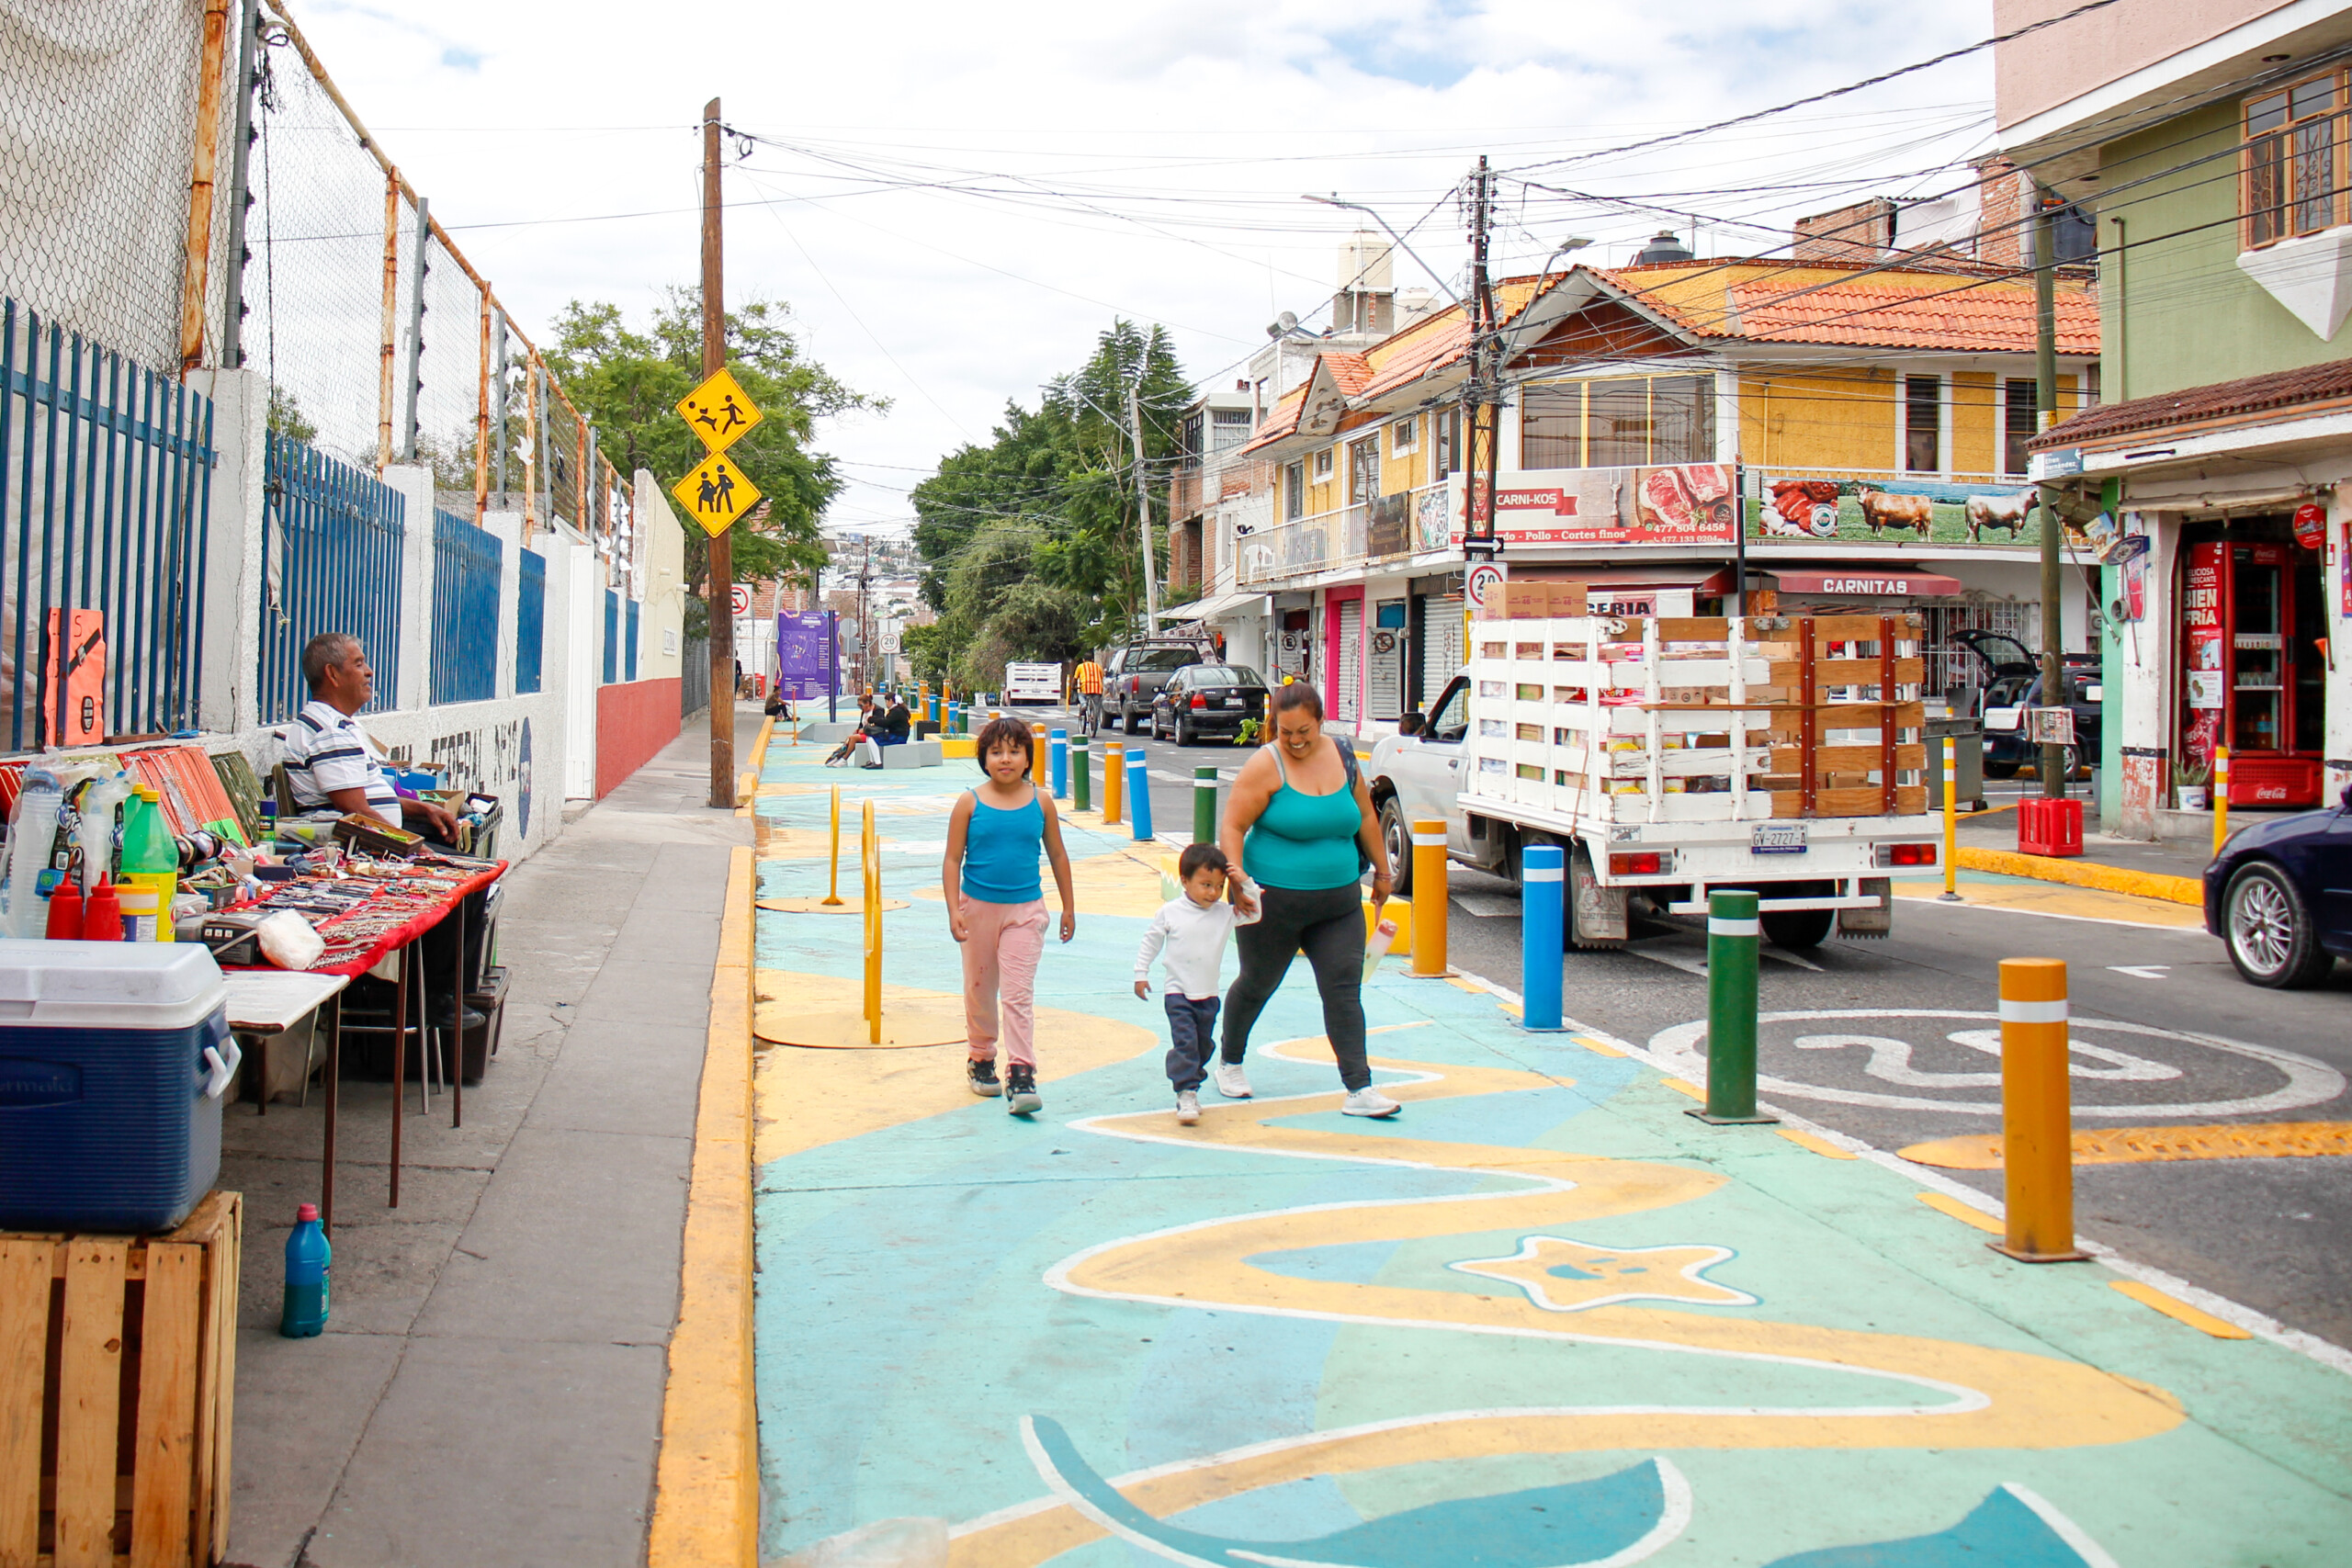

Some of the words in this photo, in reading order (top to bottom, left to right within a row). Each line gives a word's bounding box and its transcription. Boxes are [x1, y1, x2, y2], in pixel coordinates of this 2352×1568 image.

[1496, 492, 1557, 505] CARNI-KOS
[1654, 524, 1673, 533] 477
[1676, 524, 1696, 533] 804
[1699, 523, 1726, 532] 6458
[1525, 531, 1552, 541] Pollo
[1561, 530, 1596, 540] Cortes
[2187, 567, 2215, 577] ELICIOSA
[1823, 579, 1907, 594] CARNITAS
[2184, 588, 2218, 608] BIEN
[2184, 608, 2218, 626] FRÍA
[884, 637, 895, 645] 20
[1753, 832, 1806, 845] GV-2727-A
